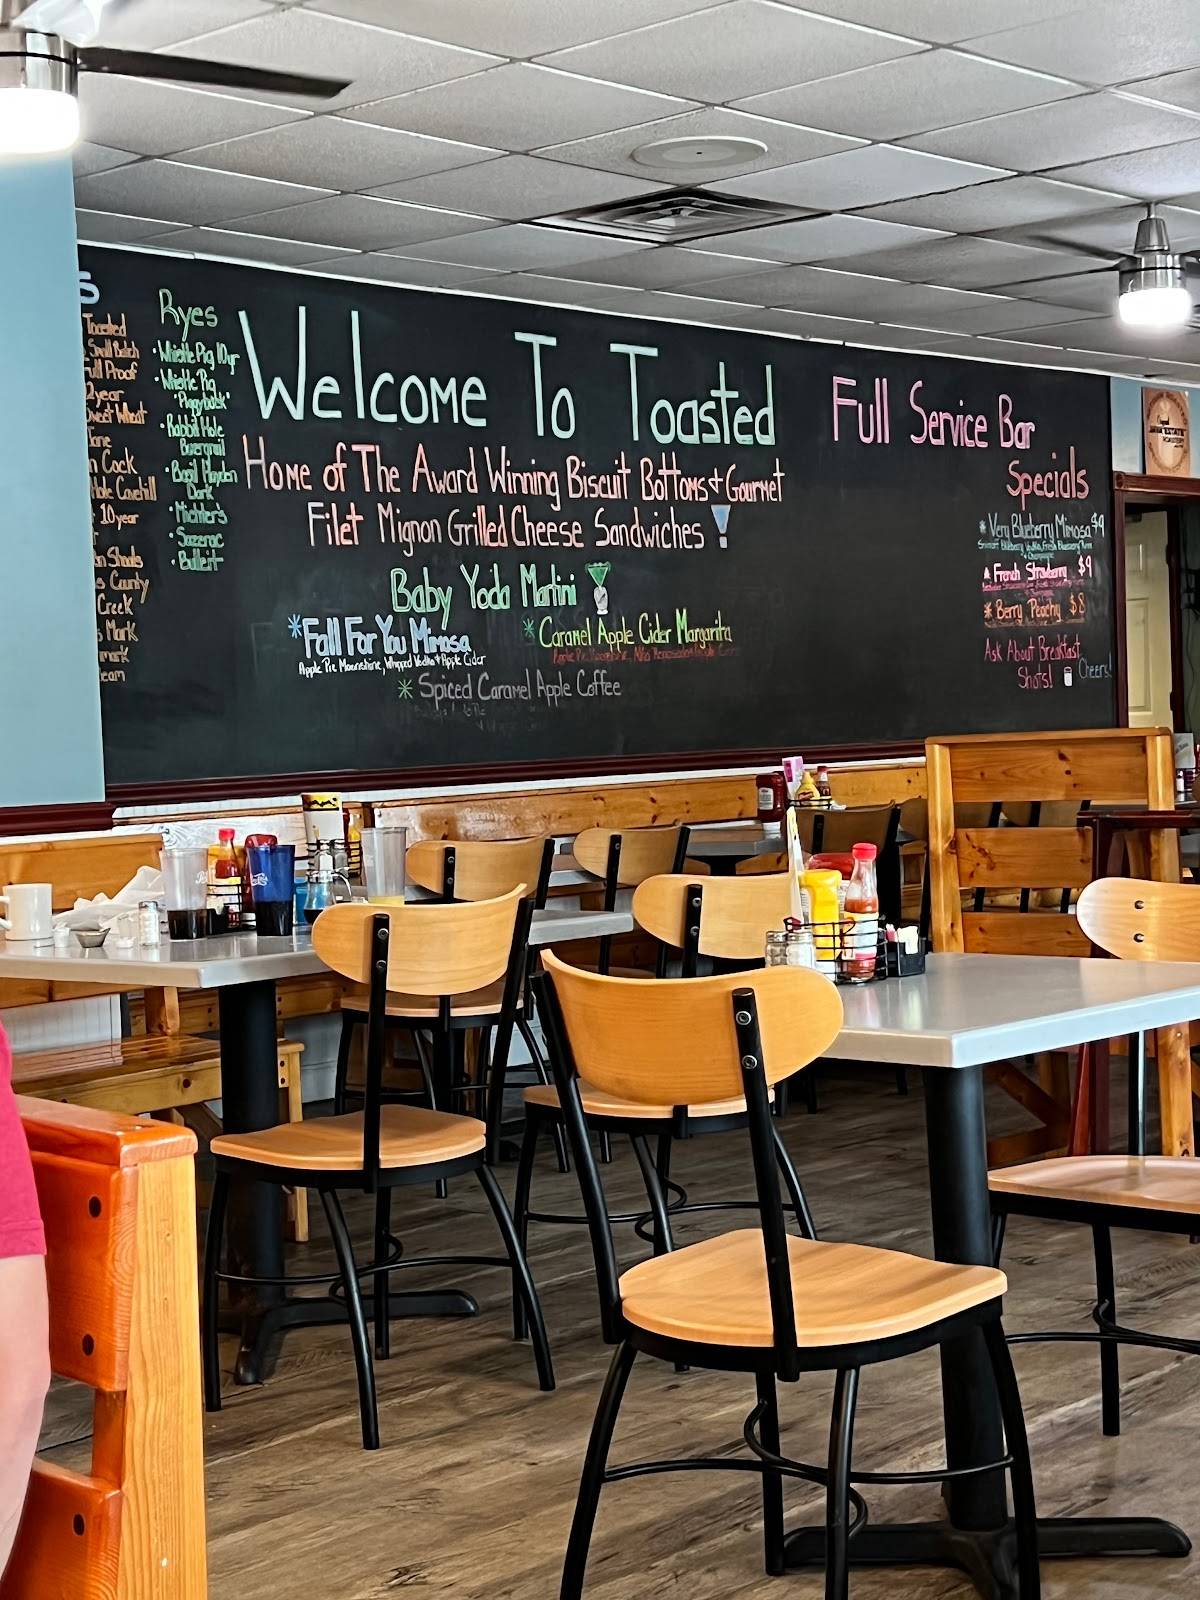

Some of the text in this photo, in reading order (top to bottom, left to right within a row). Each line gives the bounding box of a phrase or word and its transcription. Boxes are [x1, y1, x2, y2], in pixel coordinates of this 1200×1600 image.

[158, 288, 218, 342] Ryes
[105, 360, 138, 381] Proof
[158, 340, 196, 364] Whistle
[196, 342, 215, 371] Pig
[160, 368, 217, 395] Whistle Pig
[238, 306, 776, 445] Welcome To Toasted
[167, 413, 225, 438] Rabbit Hole
[832, 376, 1036, 450] Full Service Bar
[101, 447, 138, 474] Cock
[171, 459, 199, 484] Basil
[242, 434, 313, 491] Home
[323, 442, 347, 492] of
[351, 444, 401, 493] The
[412, 443, 478, 494] Award
[485, 446, 561, 511] Winning
[566, 451, 631, 499] Biscuit
[640, 451, 709, 502] Bottoms
[725, 458, 786, 502] Gourmet
[187, 481, 214, 500] Dark
[1006, 446, 1090, 511] Specials
[308, 501, 364, 546] Filet
[377, 501, 442, 557] Mignon
[448, 505, 508, 547] Grilled
[511, 504, 584, 548] Cheese
[595, 505, 705, 549] Sandwiches
[988, 512, 1010, 541] Very
[1011, 513, 1055, 543] Blueberry
[1055, 513, 1093, 539] Mimosa
[1078, 554, 1092, 578] $9
[97, 592, 134, 616] Creek
[390, 563, 577, 630] Baby Yoda Martini
[995, 599, 1023, 625] Berry
[1027, 598, 1062, 623] Peachy
[1069, 592, 1086, 616] $8
[106, 619, 139, 642] Mark
[302, 614, 472, 659] Fall For You Mimosa
[538, 607, 733, 653] Caramel Apple Cider Margarita
[984, 633, 1080, 662] Ask About Breakfast
[298, 660, 322, 678] Apple
[322, 657, 338, 673] Pie
[463, 650, 487, 666] Cider
[1017, 663, 1054, 689] Shots!
[418, 672, 473, 710] Spiced
[478, 668, 531, 701] Caramel
[536, 669, 573, 708] Apple
[577, 669, 623, 697] Coffee
